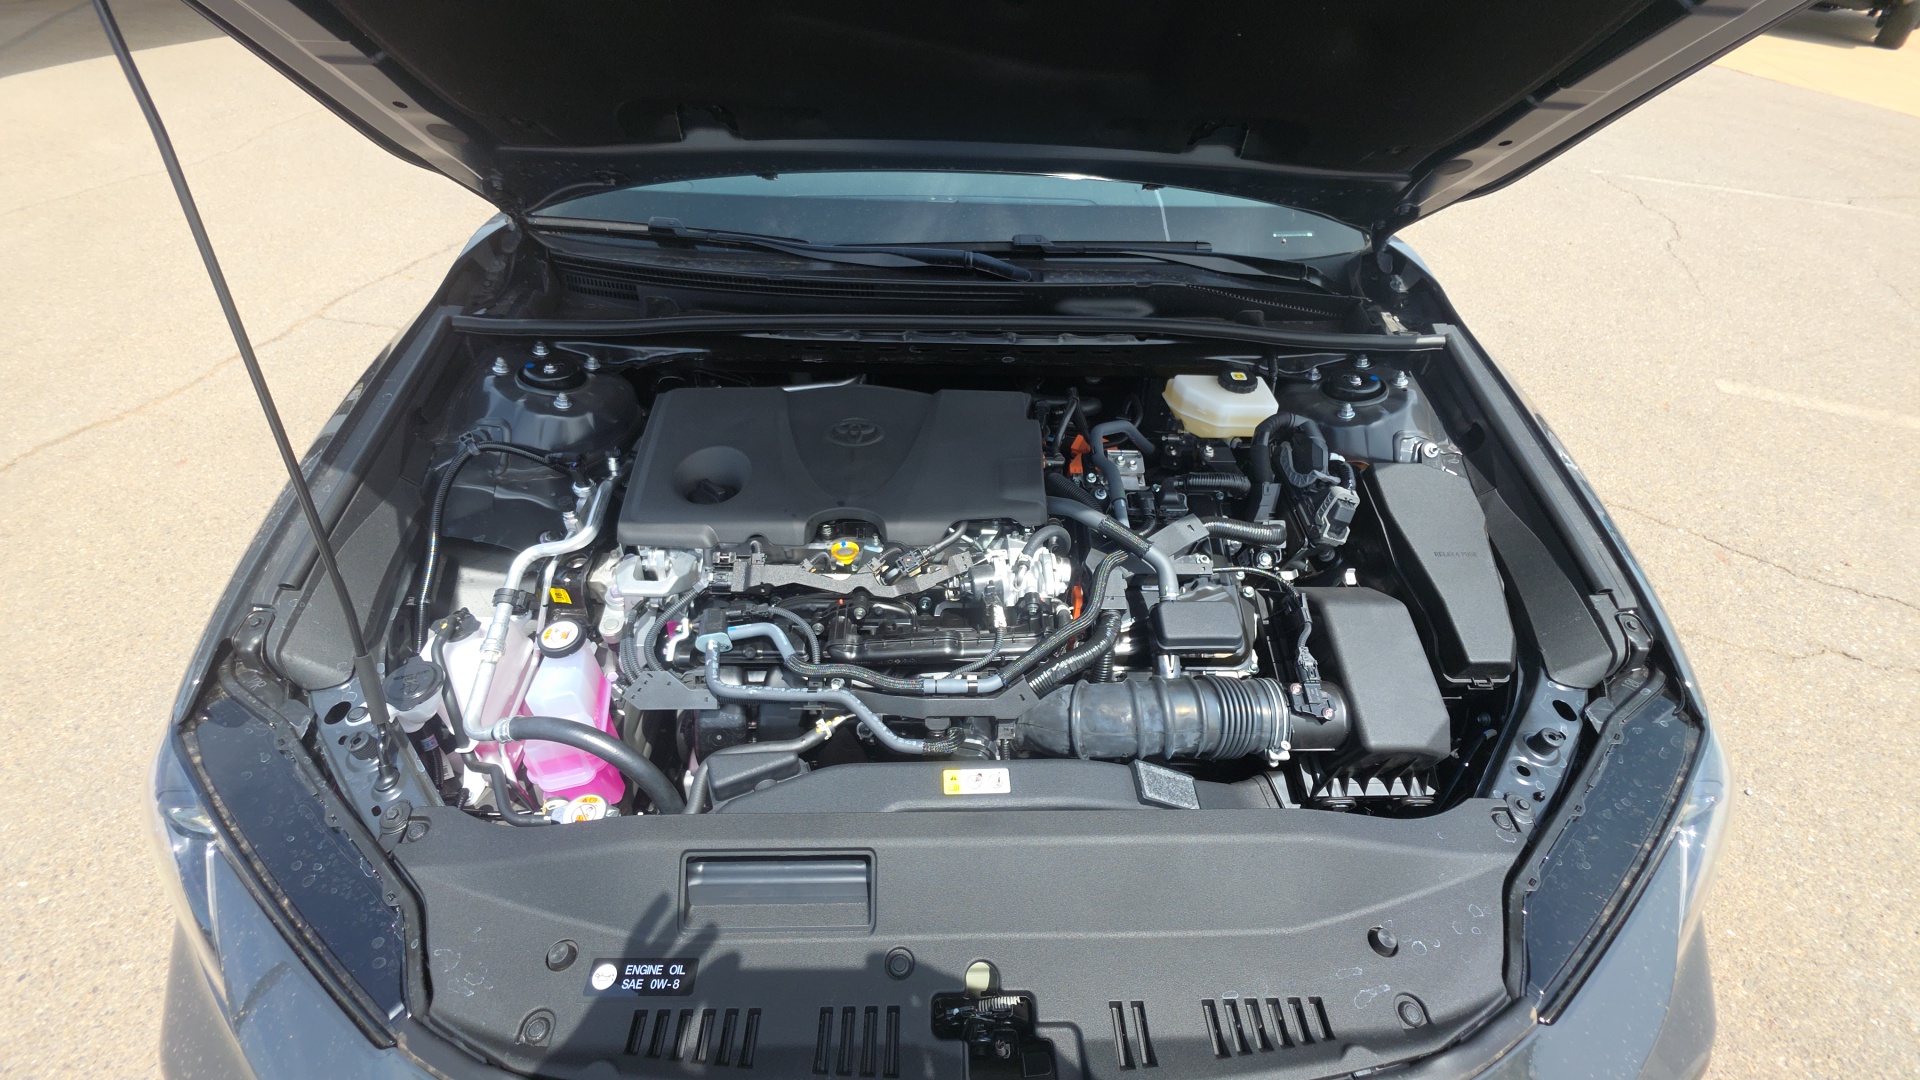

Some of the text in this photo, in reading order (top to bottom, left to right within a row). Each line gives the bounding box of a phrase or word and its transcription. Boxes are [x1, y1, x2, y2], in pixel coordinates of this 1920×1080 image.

[625, 964, 686, 975] ENGINE OIL
[621, 978, 680, 990] SAE 0W-8
